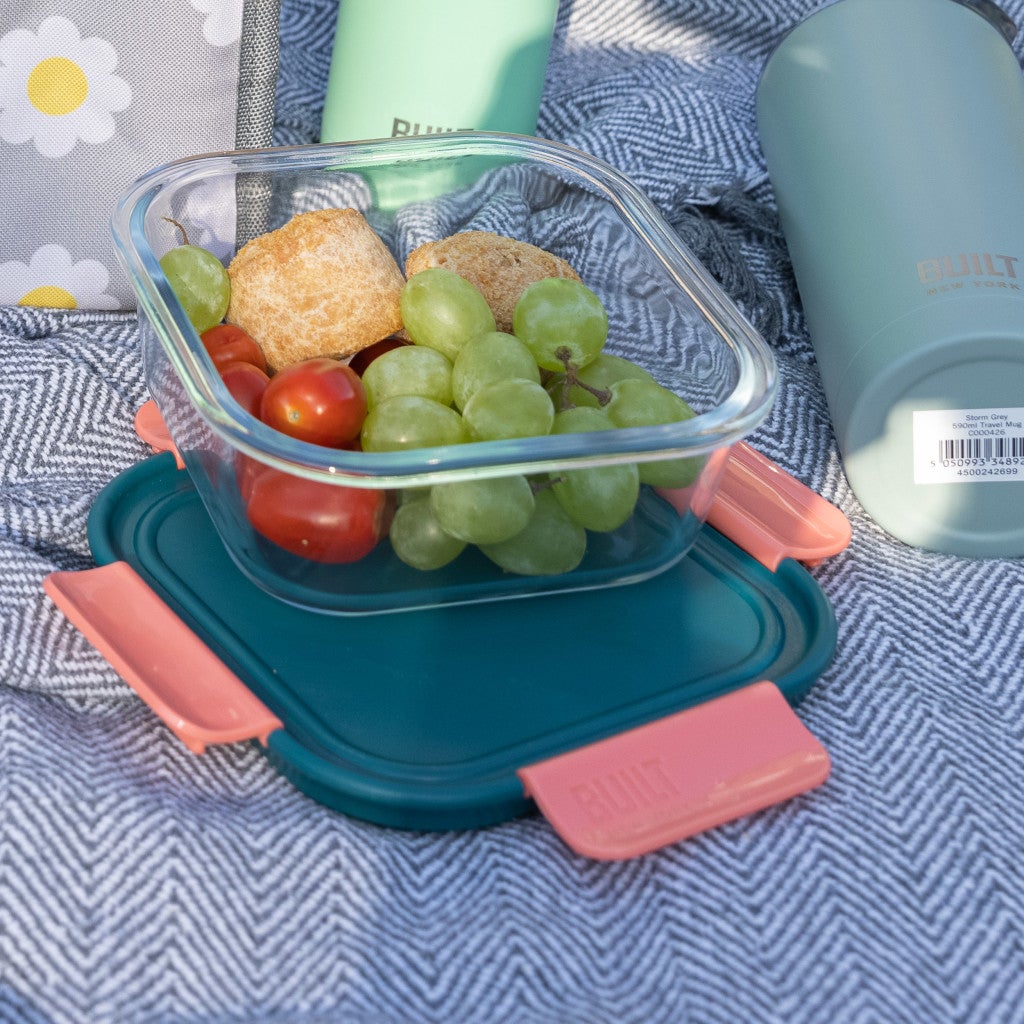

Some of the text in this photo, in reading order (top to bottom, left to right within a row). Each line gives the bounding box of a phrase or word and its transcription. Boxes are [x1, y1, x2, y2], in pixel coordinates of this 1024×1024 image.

[917, 252, 1018, 284] BUILT
[943, 458, 986, 467] 050993
[957, 467, 1018, 476] 4500242699
